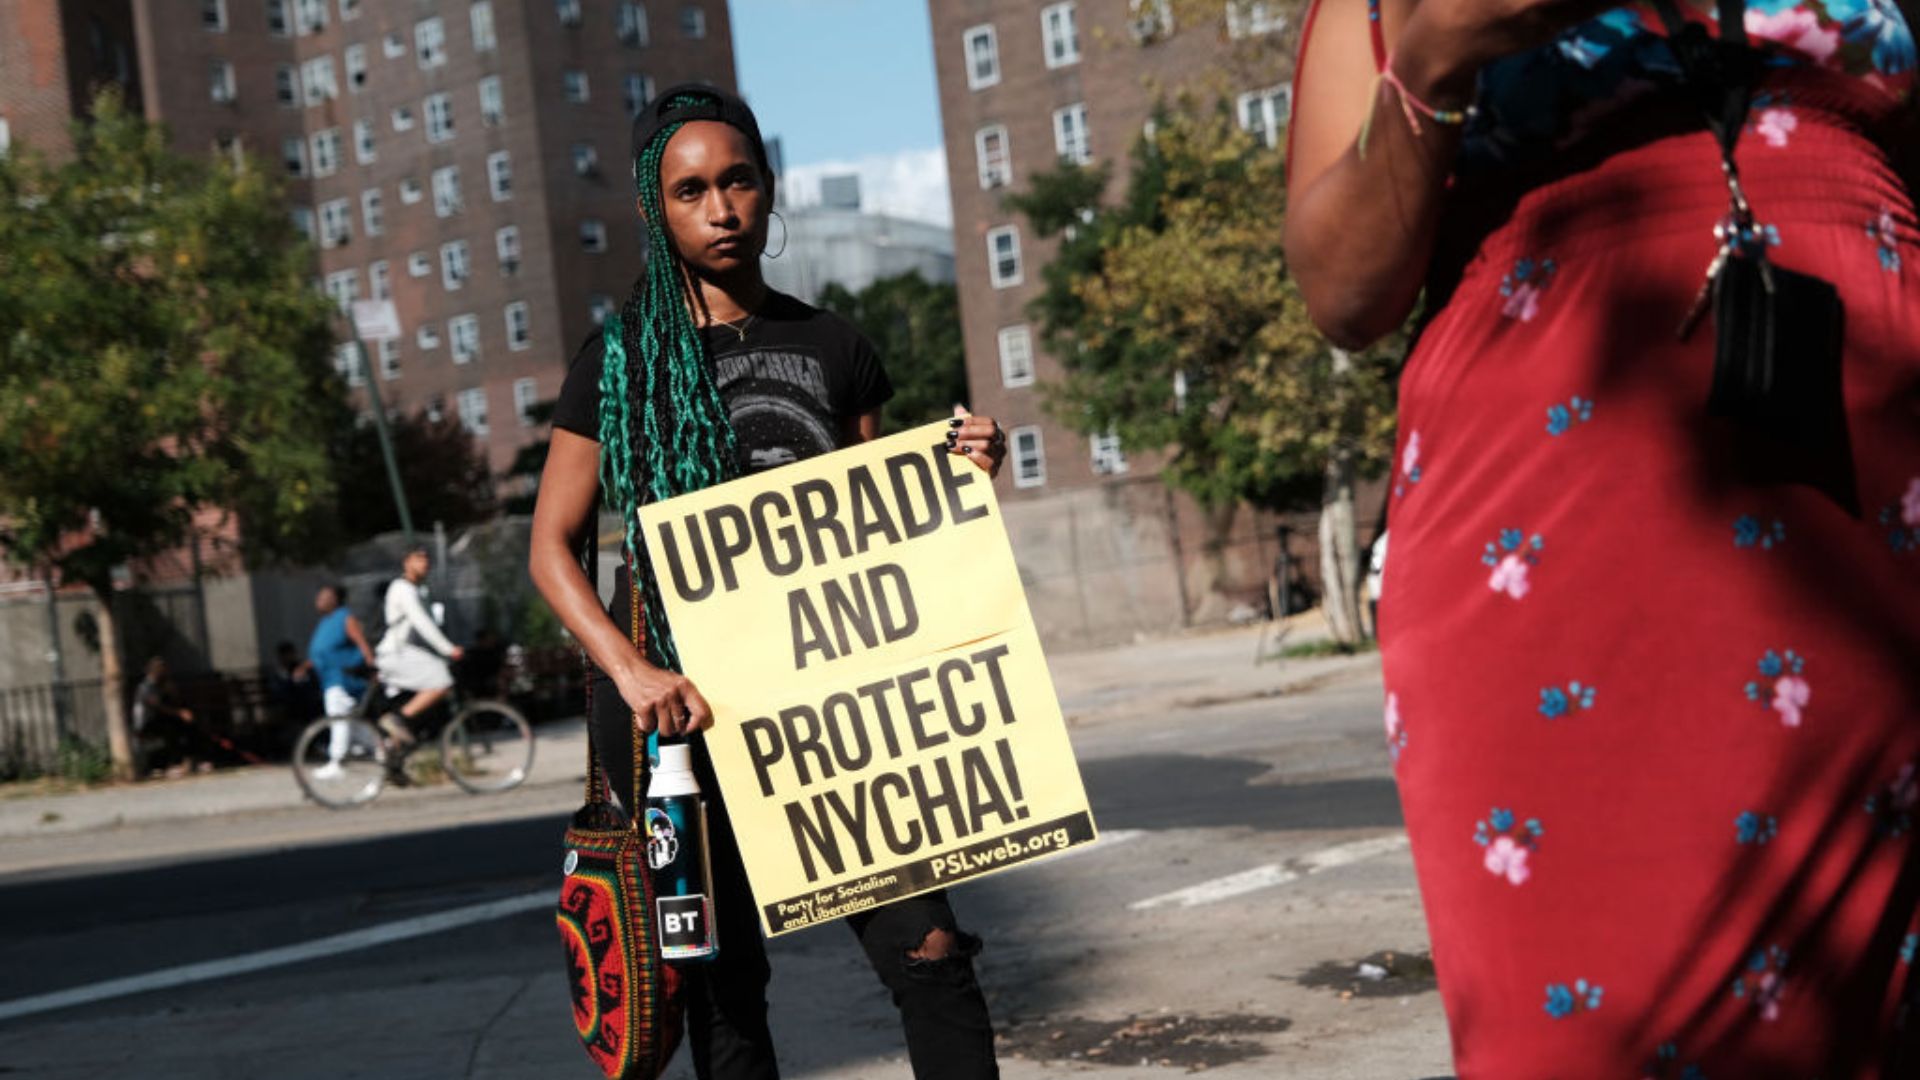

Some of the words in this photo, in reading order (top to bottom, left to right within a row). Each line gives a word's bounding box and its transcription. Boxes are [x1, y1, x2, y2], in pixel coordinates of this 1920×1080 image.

[657, 442, 990, 602] UPGRADE
[787, 563, 919, 670] AND
[740, 645, 1016, 798] PROTECT
[783, 738, 1030, 883] NYCHA!
[930, 828, 1069, 880] PSLweb.org
[664, 911, 698, 934] BT
[777, 898, 814, 917] Party
[814, 892, 834, 905] for
[837, 875, 898, 899] Socialism
[783, 913, 809, 930] and
[811, 895, 876, 922] Liberation
